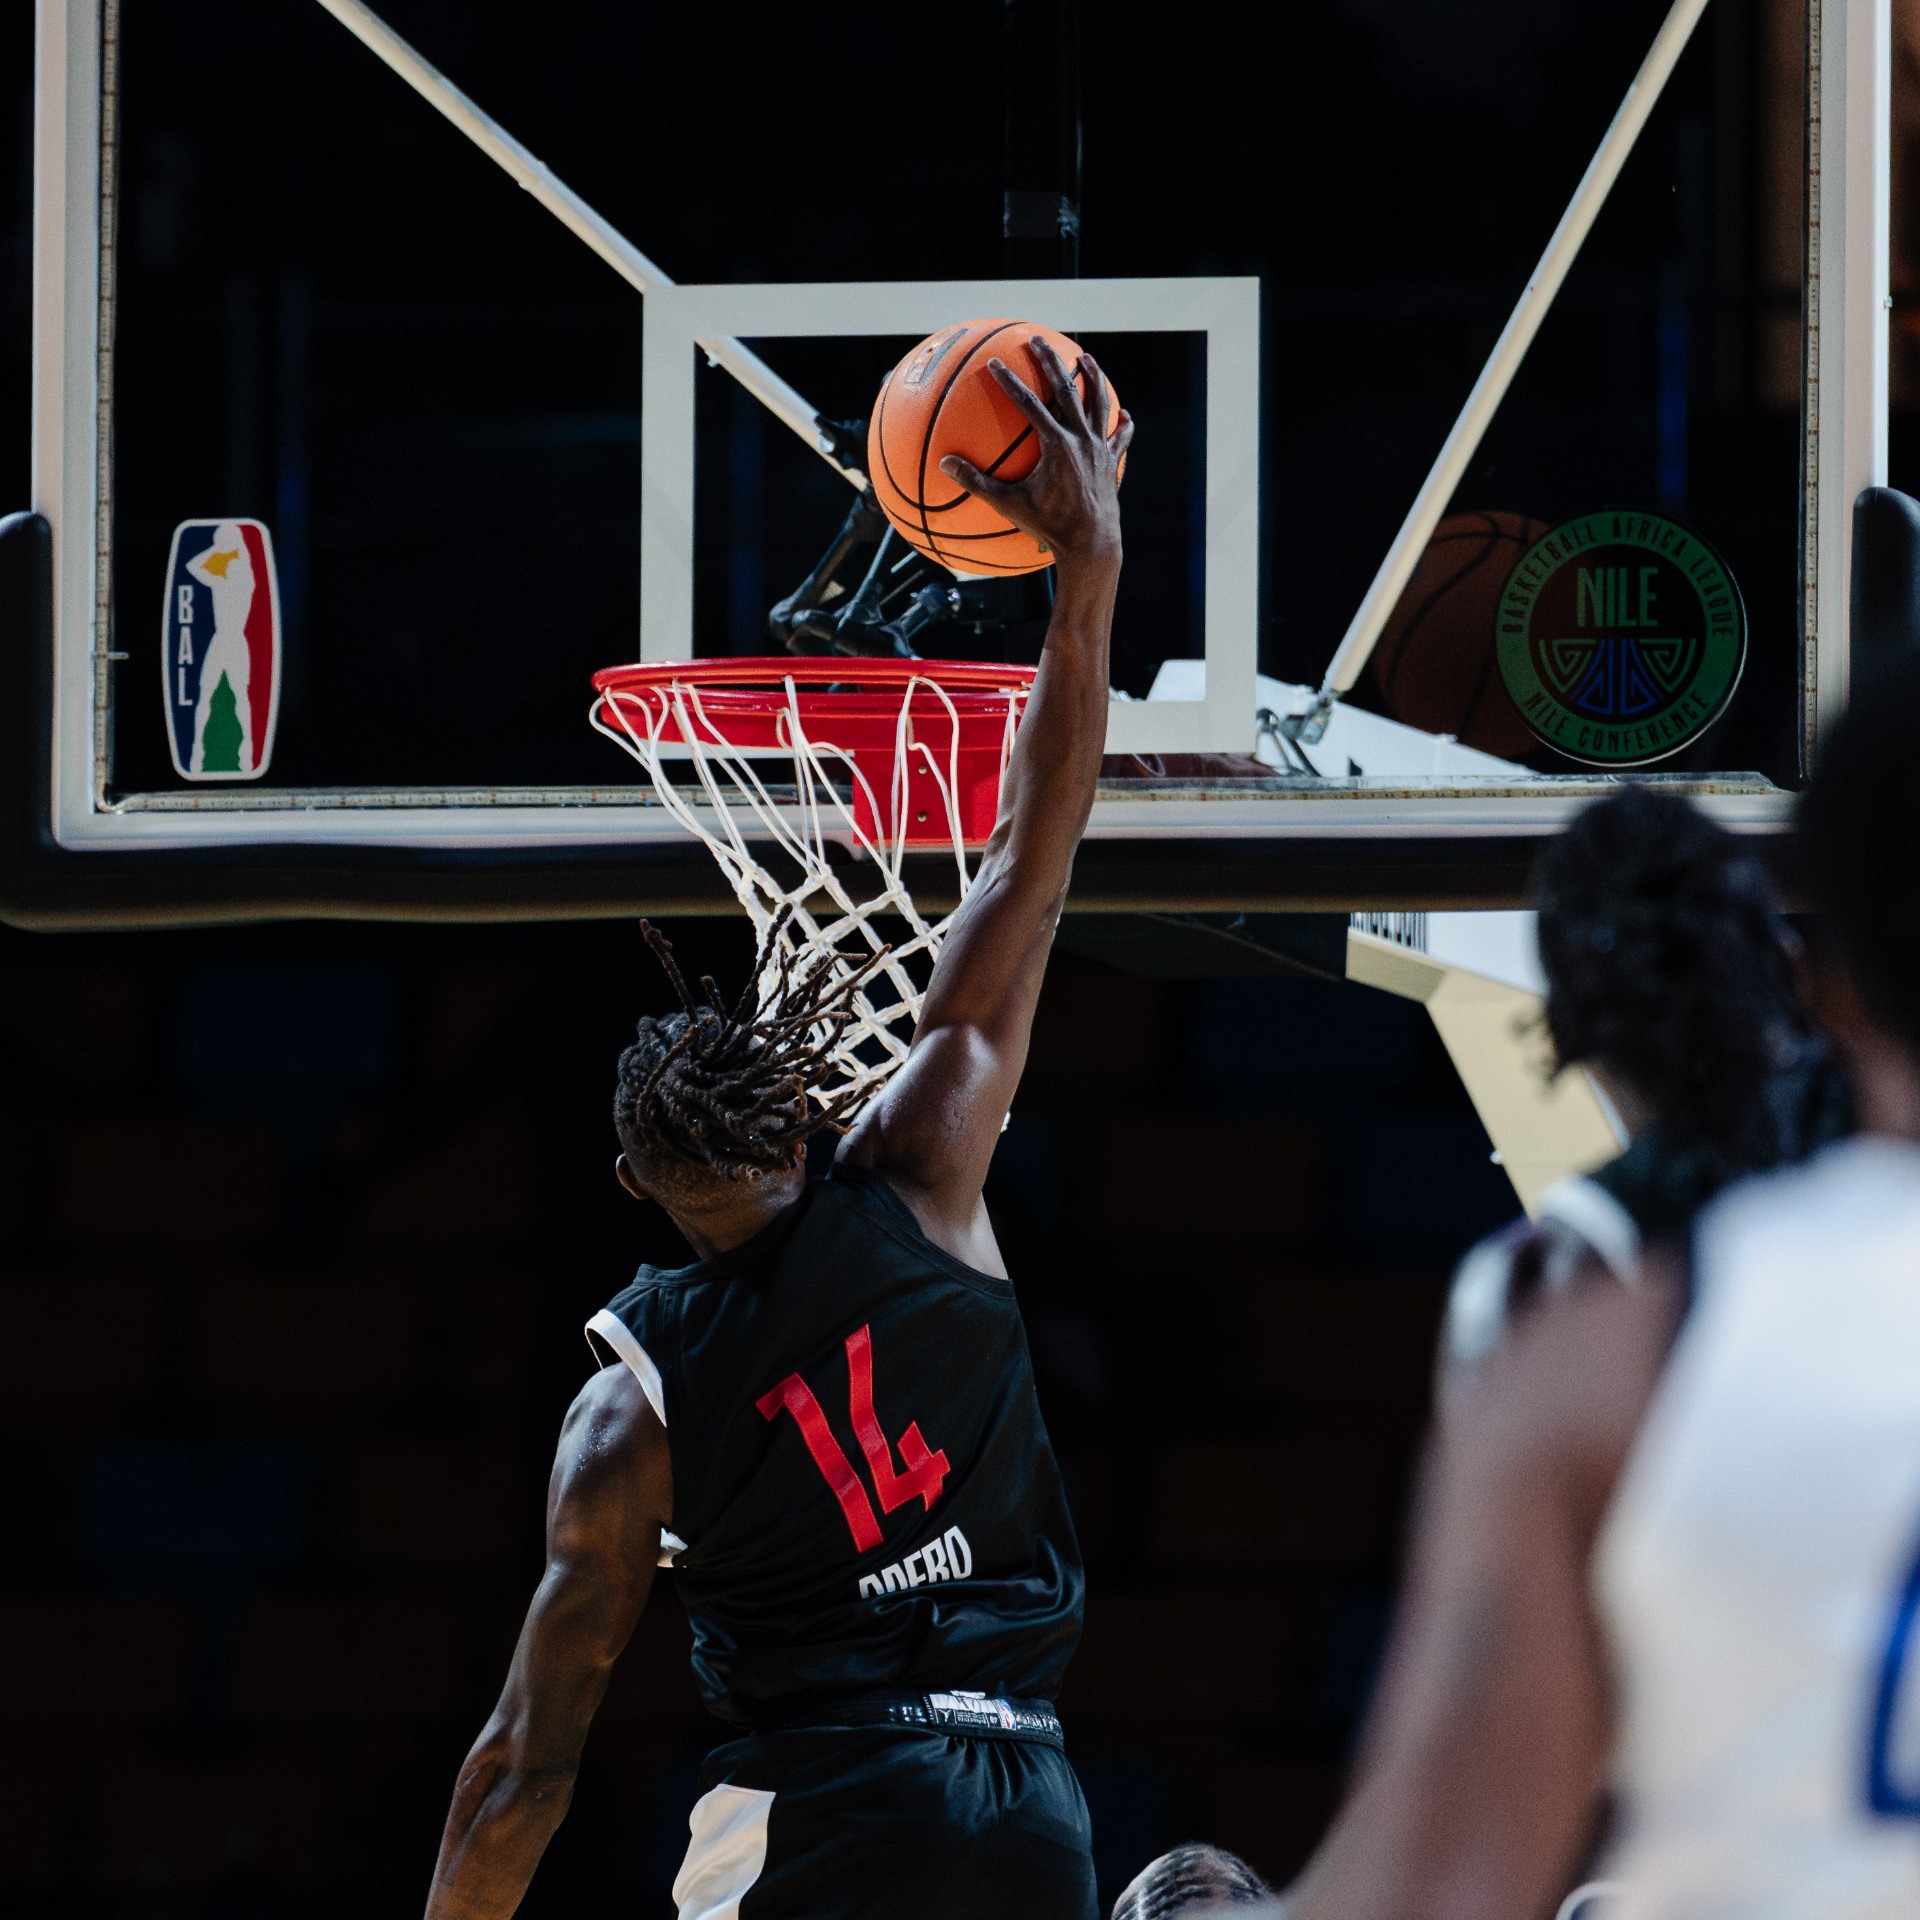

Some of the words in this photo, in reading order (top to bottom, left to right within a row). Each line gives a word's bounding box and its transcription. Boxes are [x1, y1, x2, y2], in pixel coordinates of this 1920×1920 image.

[1502, 523, 1597, 634] BASKETBALL
[1612, 515, 1688, 555] AFRICA
[1690, 556, 1734, 636] LEAGUE
[1576, 567, 1659, 627] NILE
[178, 585, 194, 706] BAL
[1524, 692, 1569, 736] NILE
[1578, 692, 1708, 752] CONFERENCE
[755, 1323, 951, 1553] 14
